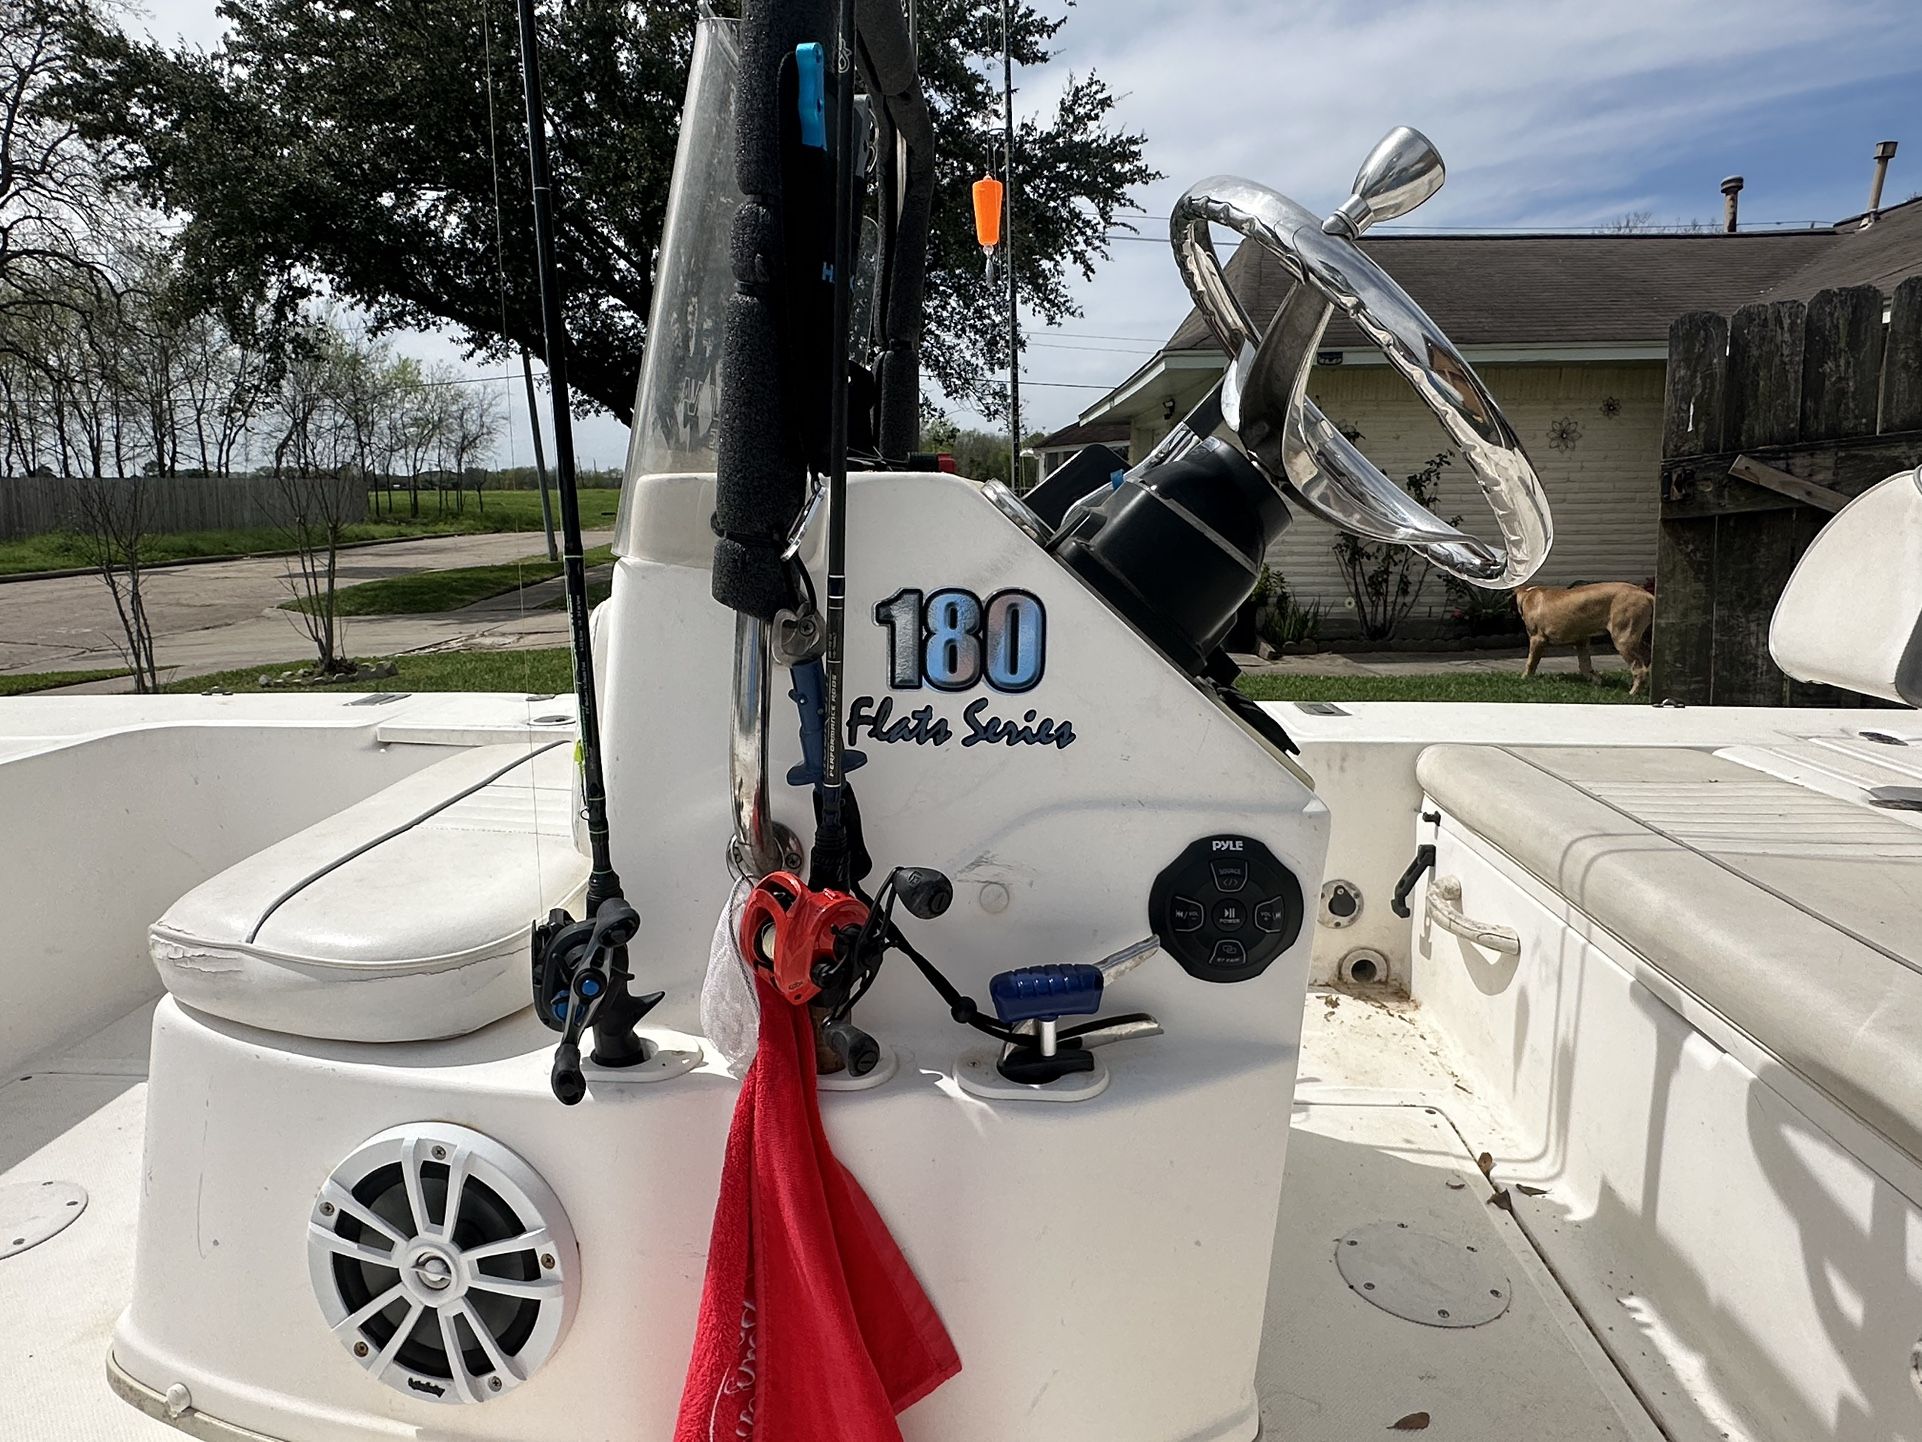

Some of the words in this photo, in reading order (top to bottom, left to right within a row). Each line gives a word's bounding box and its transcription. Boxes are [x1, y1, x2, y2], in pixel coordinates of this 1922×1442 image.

[872, 587, 1047, 694] 180
[829, 704, 837, 777] PERFORMANCE
[846, 696, 953, 747] Flats
[961, 697, 1077, 750] Series
[1212, 840, 1244, 851] PYLE
